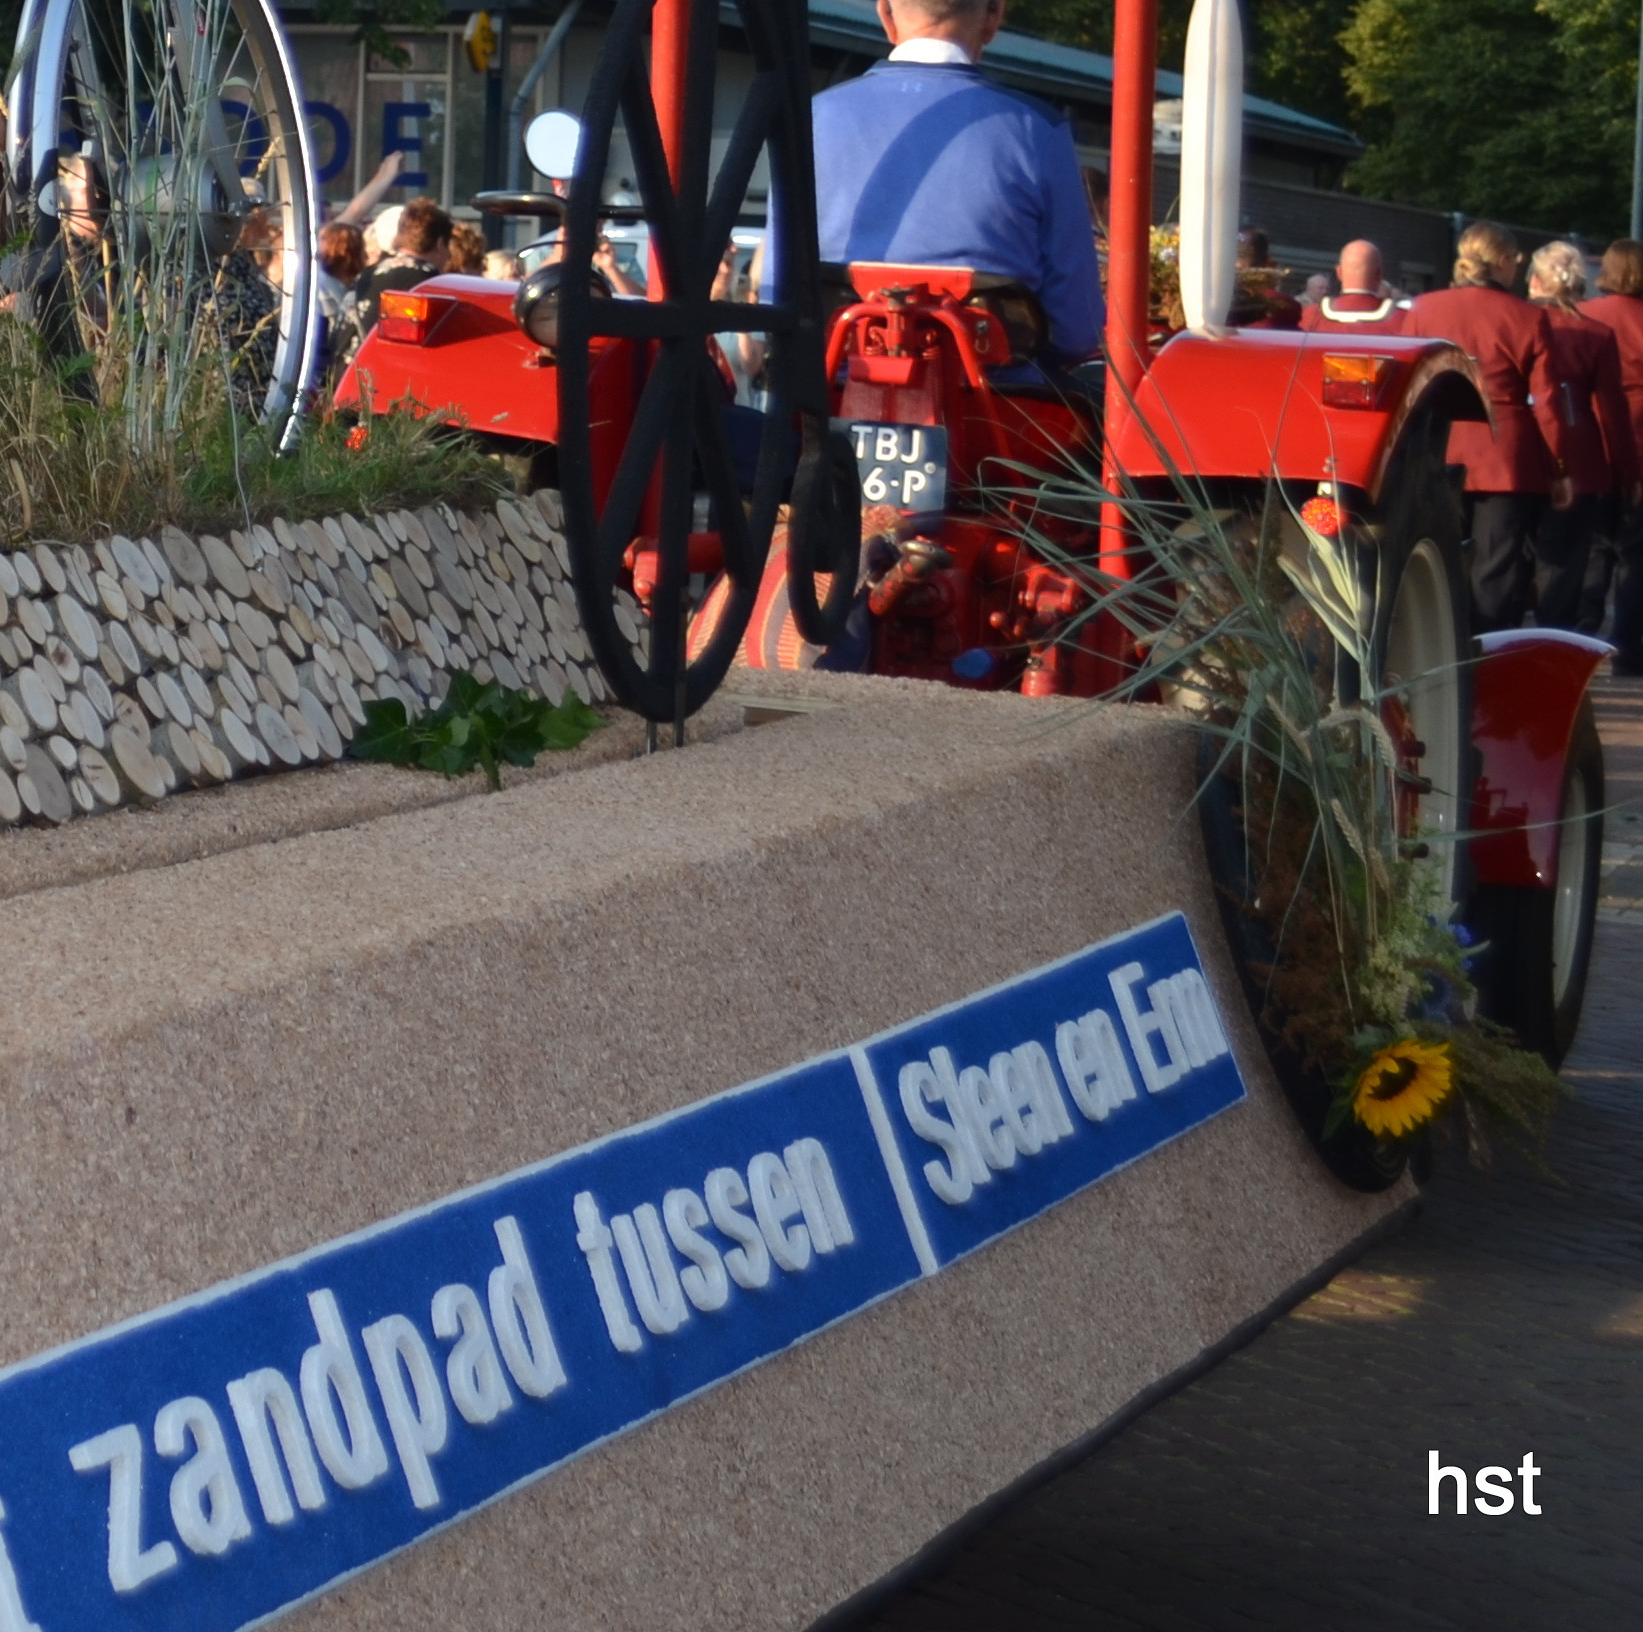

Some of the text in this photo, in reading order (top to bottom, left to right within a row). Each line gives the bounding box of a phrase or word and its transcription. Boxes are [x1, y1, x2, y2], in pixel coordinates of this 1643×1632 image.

[851, 424, 921, 464] TBJ
[67, 1215, 567, 1593] zandpad
[573, 1136, 855, 1353] tussen
[898, 1045, 1074, 1205] Sleen
[1055, 1007, 1138, 1122] en
[1107, 960, 1229, 1094] Erm
